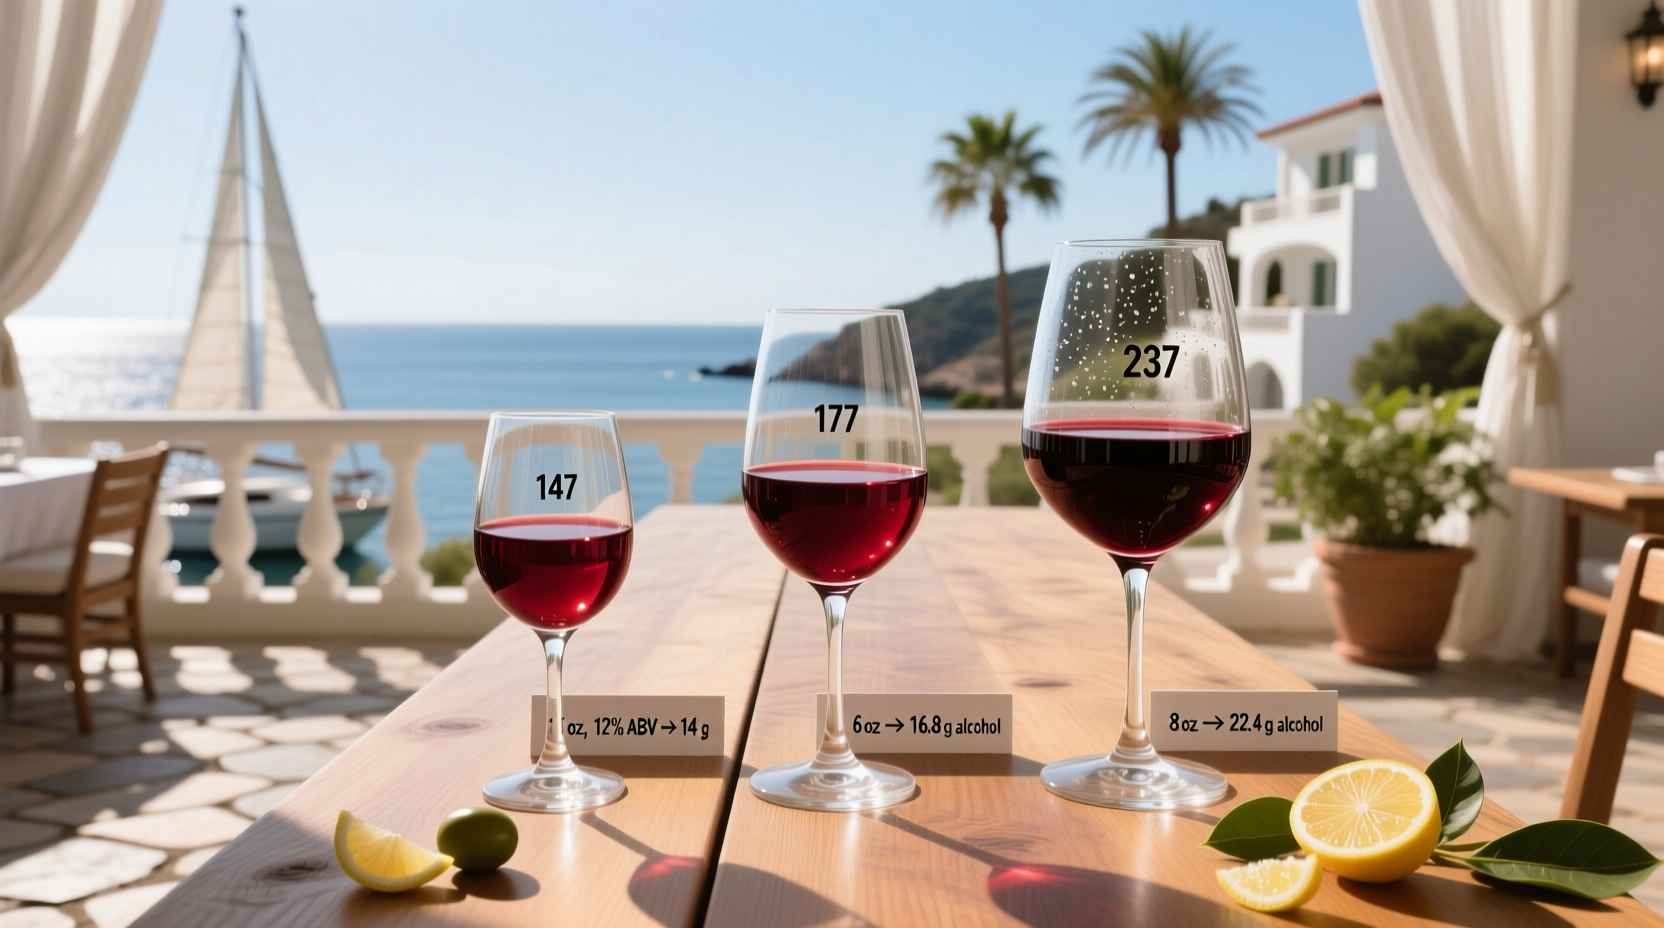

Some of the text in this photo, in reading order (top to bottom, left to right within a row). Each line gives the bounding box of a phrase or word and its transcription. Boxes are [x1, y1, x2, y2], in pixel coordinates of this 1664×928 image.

[1123, 344, 1180, 379] 237
[814, 404, 859, 433] 177
[536, 473, 578, 500] 147
[567, 722, 588, 740] oz,
[593, 716, 624, 736] 12%
[626, 717, 659, 736] ABV
[680, 716, 698, 737] 14
[700, 723, 710, 741] g
[955, 717, 1001, 734] alcohol
[1276, 715, 1324, 733] alcohol
